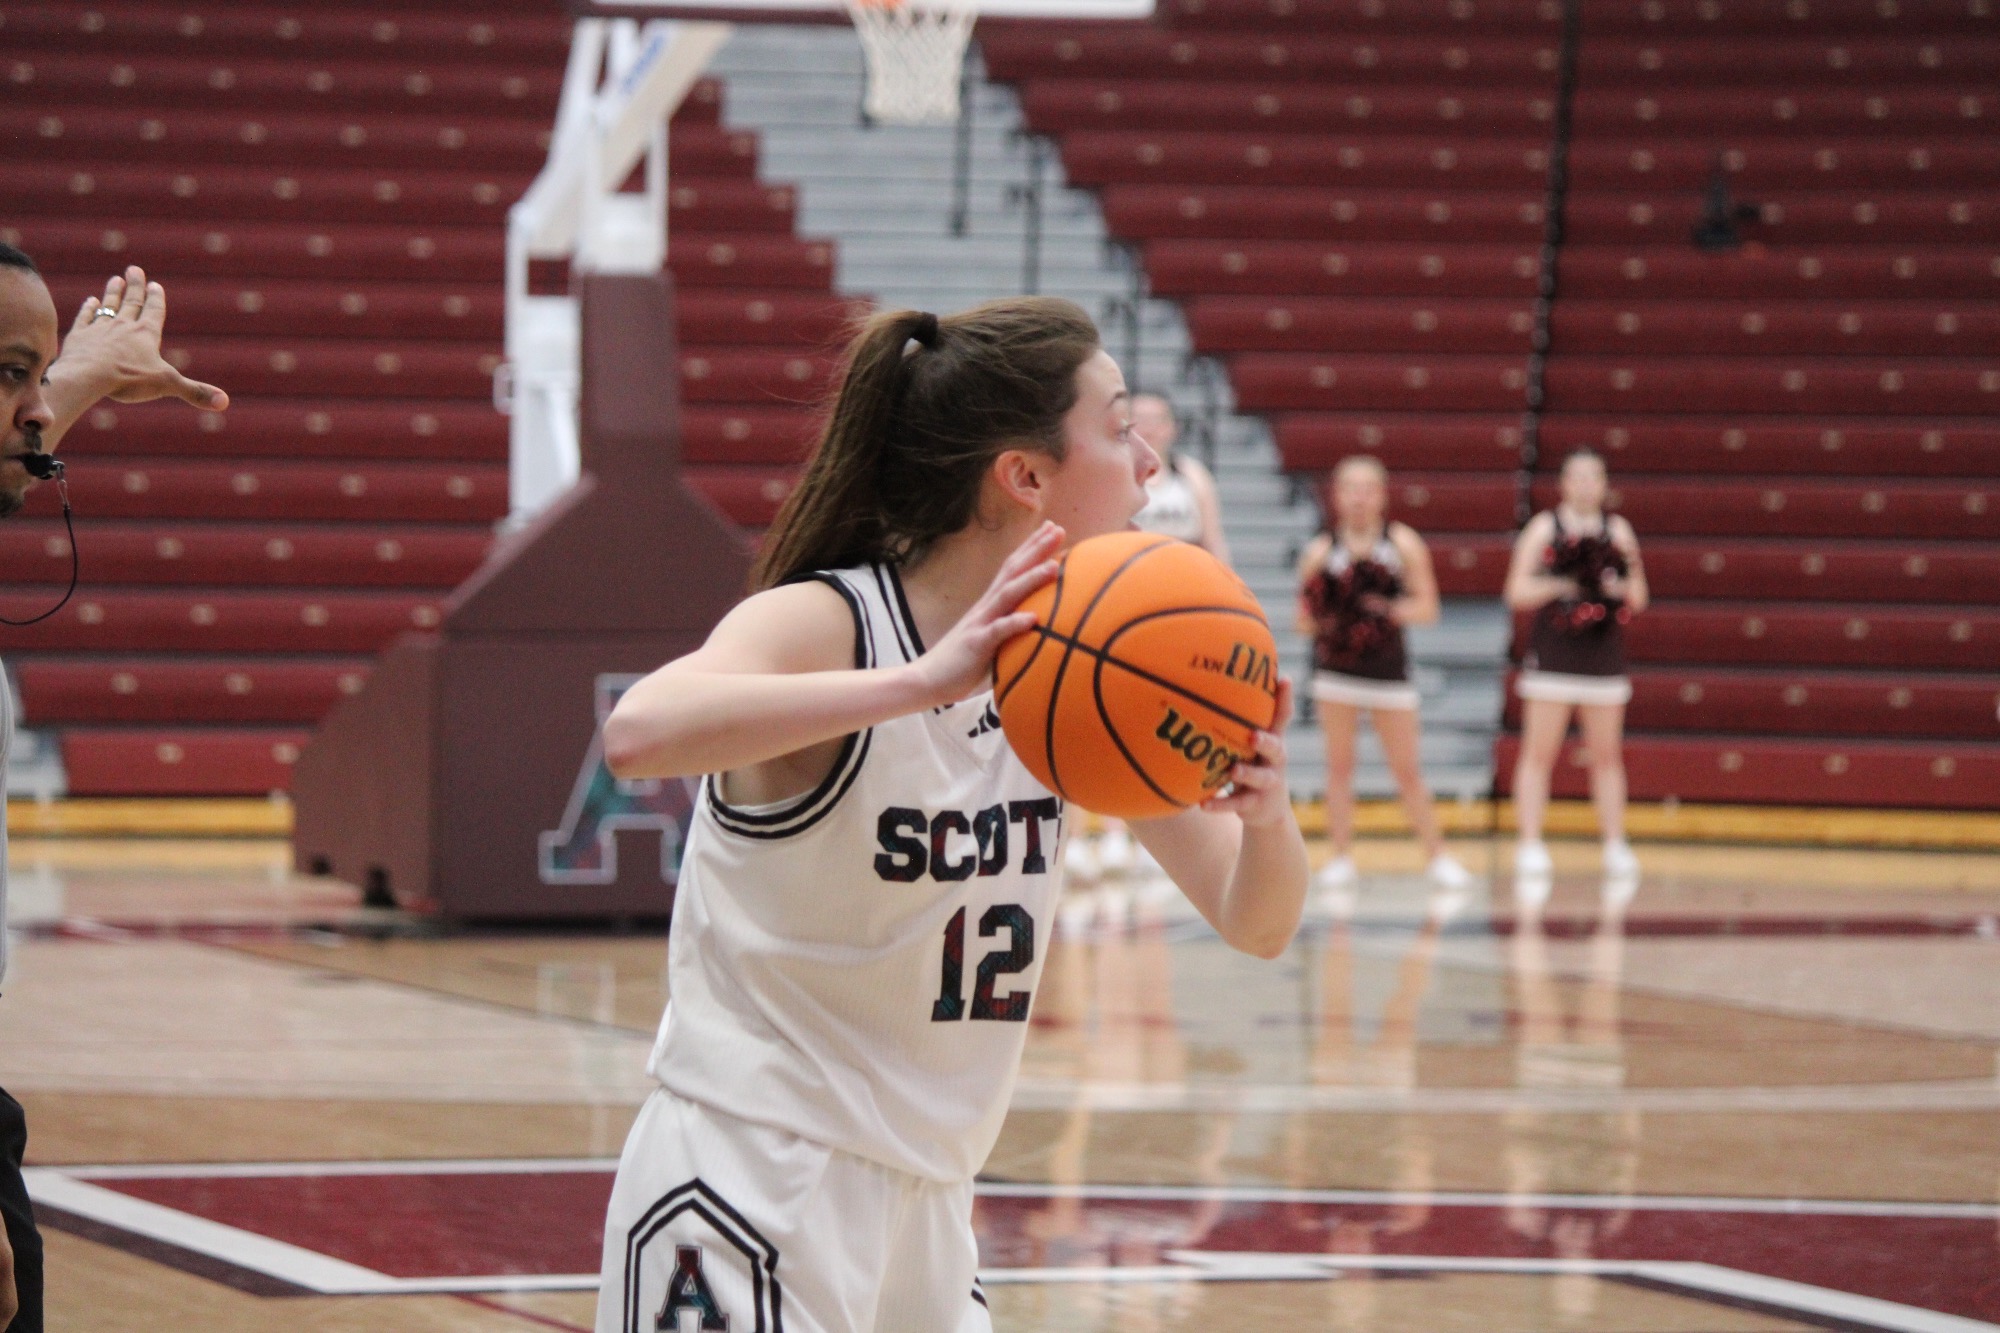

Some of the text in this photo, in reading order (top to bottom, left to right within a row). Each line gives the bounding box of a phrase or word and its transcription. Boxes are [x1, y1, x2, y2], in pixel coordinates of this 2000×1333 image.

[1225, 642, 1276, 697] VO
[874, 797, 1063, 882] SCOT
[930, 904, 1034, 1022] 12
[654, 1245, 730, 1332] A
